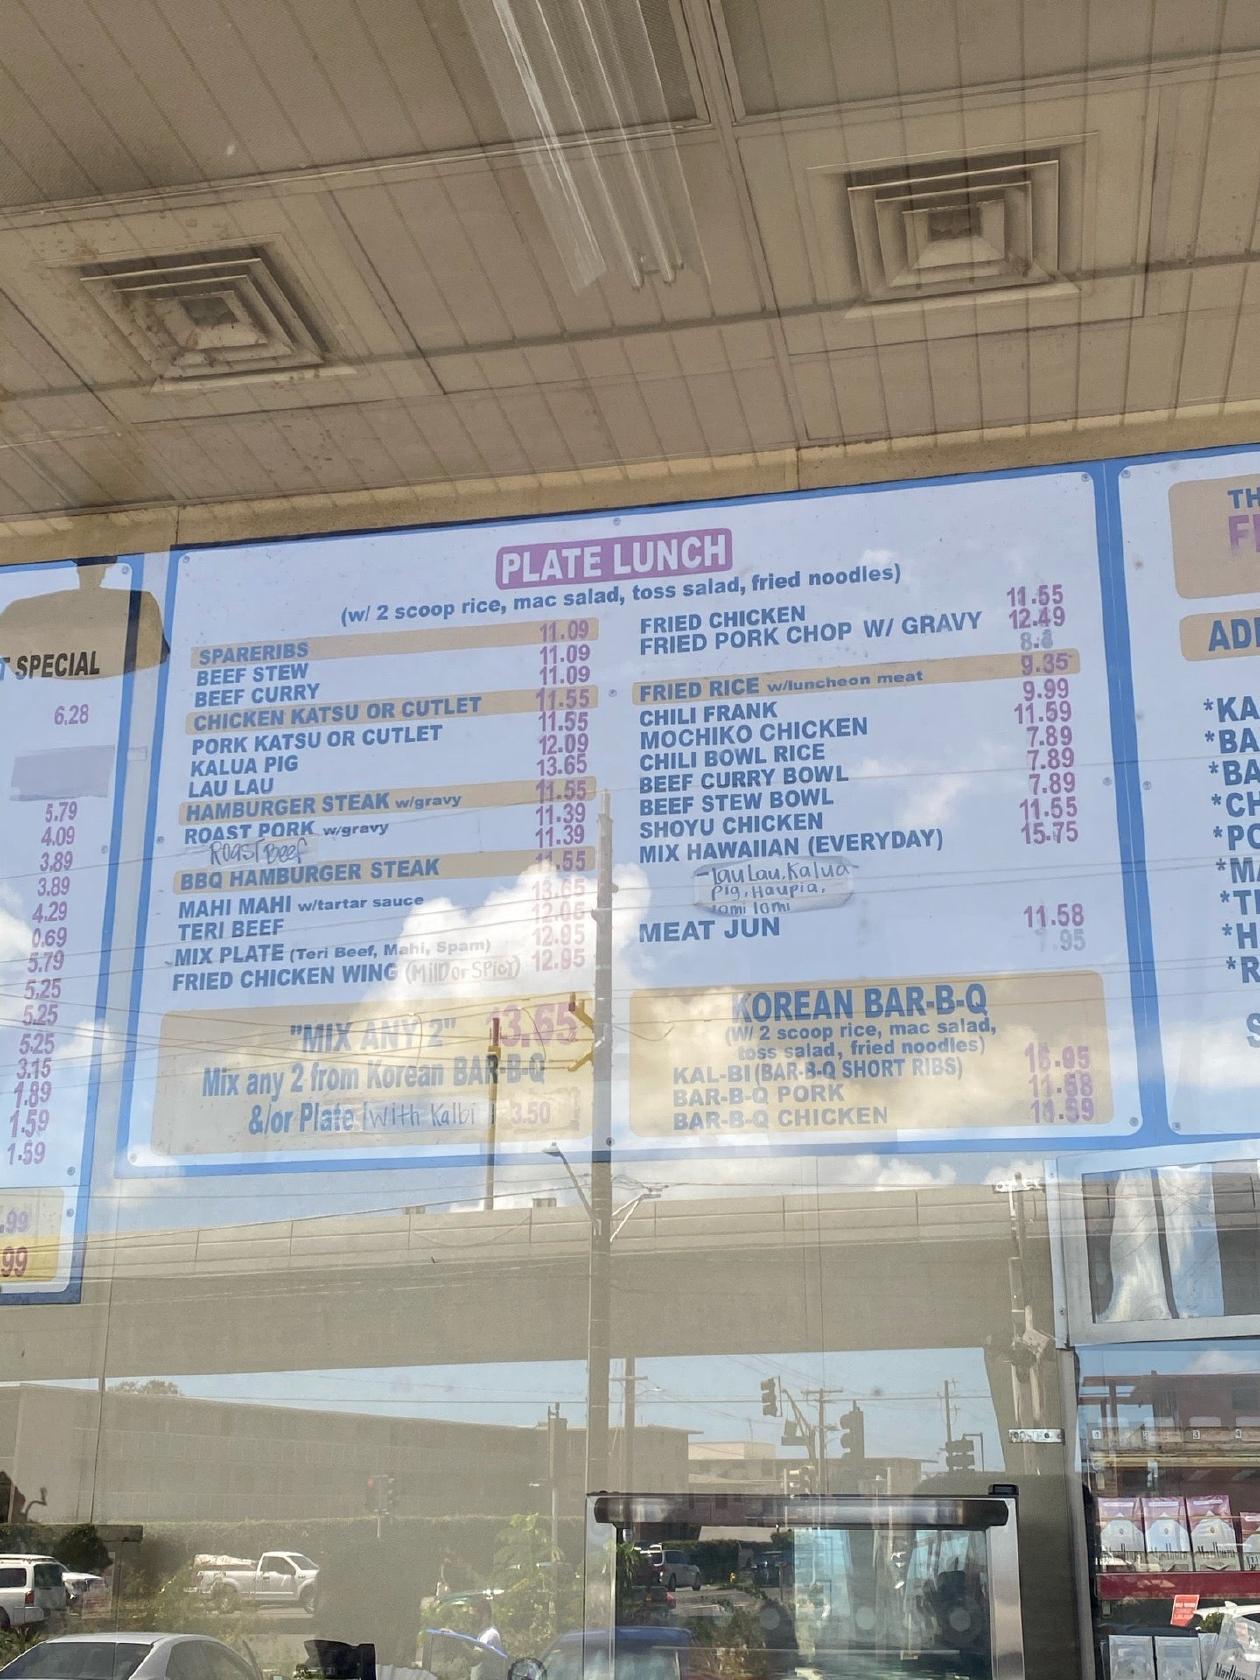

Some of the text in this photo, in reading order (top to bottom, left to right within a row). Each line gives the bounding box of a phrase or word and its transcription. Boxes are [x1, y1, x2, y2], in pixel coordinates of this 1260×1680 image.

[501, 533, 727, 586] PLATE LUNCH
[340, 563, 901, 627] (w/ 2 scoop rice, mac salad, toss salad, fried noodles)
[1005, 583, 1065, 607] 11.55
[540, 618, 590, 642] 11.09
[640, 605, 806, 635] FRIED CHICKEN
[1007, 606, 1067, 631] 12.49
[640, 610, 984, 656] FRIED PORK CHOP W/ GRAVY
[15, 650, 100, 680] SPECIAL
[199, 642, 310, 665] SPARERIBS
[540, 644, 591, 665] 11.09
[196, 662, 310, 687] BEEF STEW
[539, 665, 591, 688] 11.09
[640, 669, 924, 704] FRIED RICE w/luncheon meat
[195, 683, 321, 708] BEEF CURRY
[536, 688, 591, 710] 11.55
[1023, 678, 1070, 702] 9.99
[53, 703, 90, 726] 6.28
[193, 696, 482, 732] CHICKEN KATSU OR CUTLET
[538, 711, 590, 734] 11.55
[639, 701, 779, 728] CHILI FRANK
[192, 725, 443, 756] PORK KATSU OR CUTLET
[539, 733, 590, 756] 12.09
[640, 716, 869, 750] MOCHIKO CHICKEN
[1026, 725, 1074, 748] 7.89
[190, 755, 299, 779] KALUA PIG
[536, 755, 588, 778] 13.65
[639, 743, 826, 773] CHILI BOWL RICE
[1027, 748, 1076, 772] 7.89
[188, 777, 274, 799] LAU LAU
[535, 778, 588, 802] 11.55
[639, 765, 850, 795] BEEF CURRY BOWL
[1028, 771, 1077, 795] 7.89
[45, 800, 78, 824] 5.79
[185, 793, 462, 823] HAMBURGER STEAK w/gravy
[535, 803, 587, 826] 11.39
[639, 788, 835, 818] BEEF STEW BOWL
[1019, 796, 1078, 821] 11.55
[40, 825, 76, 847] 4.09
[184, 819, 389, 845] ROAST PORK w/gravy
[535, 825, 586, 848] 11.39
[639, 811, 824, 840] SHOYU CHICKEN
[1021, 820, 1079, 845] 15.75
[639, 828, 944, 865] MIX HAWAIIAN (EVERYDAY)
[39, 850, 74, 873] 3.89
[37, 875, 71, 897] 3.89
[180, 858, 440, 891] BBQ HAMBURGER STEAK
[32, 900, 69, 924] 4.29
[178, 894, 424, 920] MAHI MAHI w/tartar sauce
[1023, 902, 1085, 929] 11.58
[32, 926, 68, 948] 0.69
[177, 918, 285, 941] TERI BEEF
[639, 916, 781, 944] MEAT JUN
[27, 949, 65, 973] 5.79
[174, 937, 491, 967] MIX PLATE (Teri Beef, Mahi, Spam)
[24, 977, 62, 1000] 5.25
[172, 962, 398, 992] FRIED CHICKEN WING
[22, 1003, 59, 1026] 5.25
[731, 983, 989, 1024] KOREAN BAR-B-Q
[290, 1018, 421, 1053] "MIX ANY
[759, 1016, 997, 1045] 2 scoop rice, mac salad,
[19, 1032, 56, 1055] 5.25
[738, 1036, 986, 1063] toss salad, fried noodles)
[16, 1057, 52, 1080] 3.15
[202, 1053, 545, 1102] Mix any 2 from Korean BAR-B-Q
[841, 1057, 906, 1079] SHORT
[12, 1080, 52, 1108] 1.89
[672, 1082, 845, 1109] BAR-B-Q PORK
[9, 1108, 50, 1138] 1.59
[249, 1102, 354, 1135] &/or Plate
[672, 1106, 890, 1132] BAR-B-Q CHICKEN
[6, 1141, 47, 1166] 1.59
